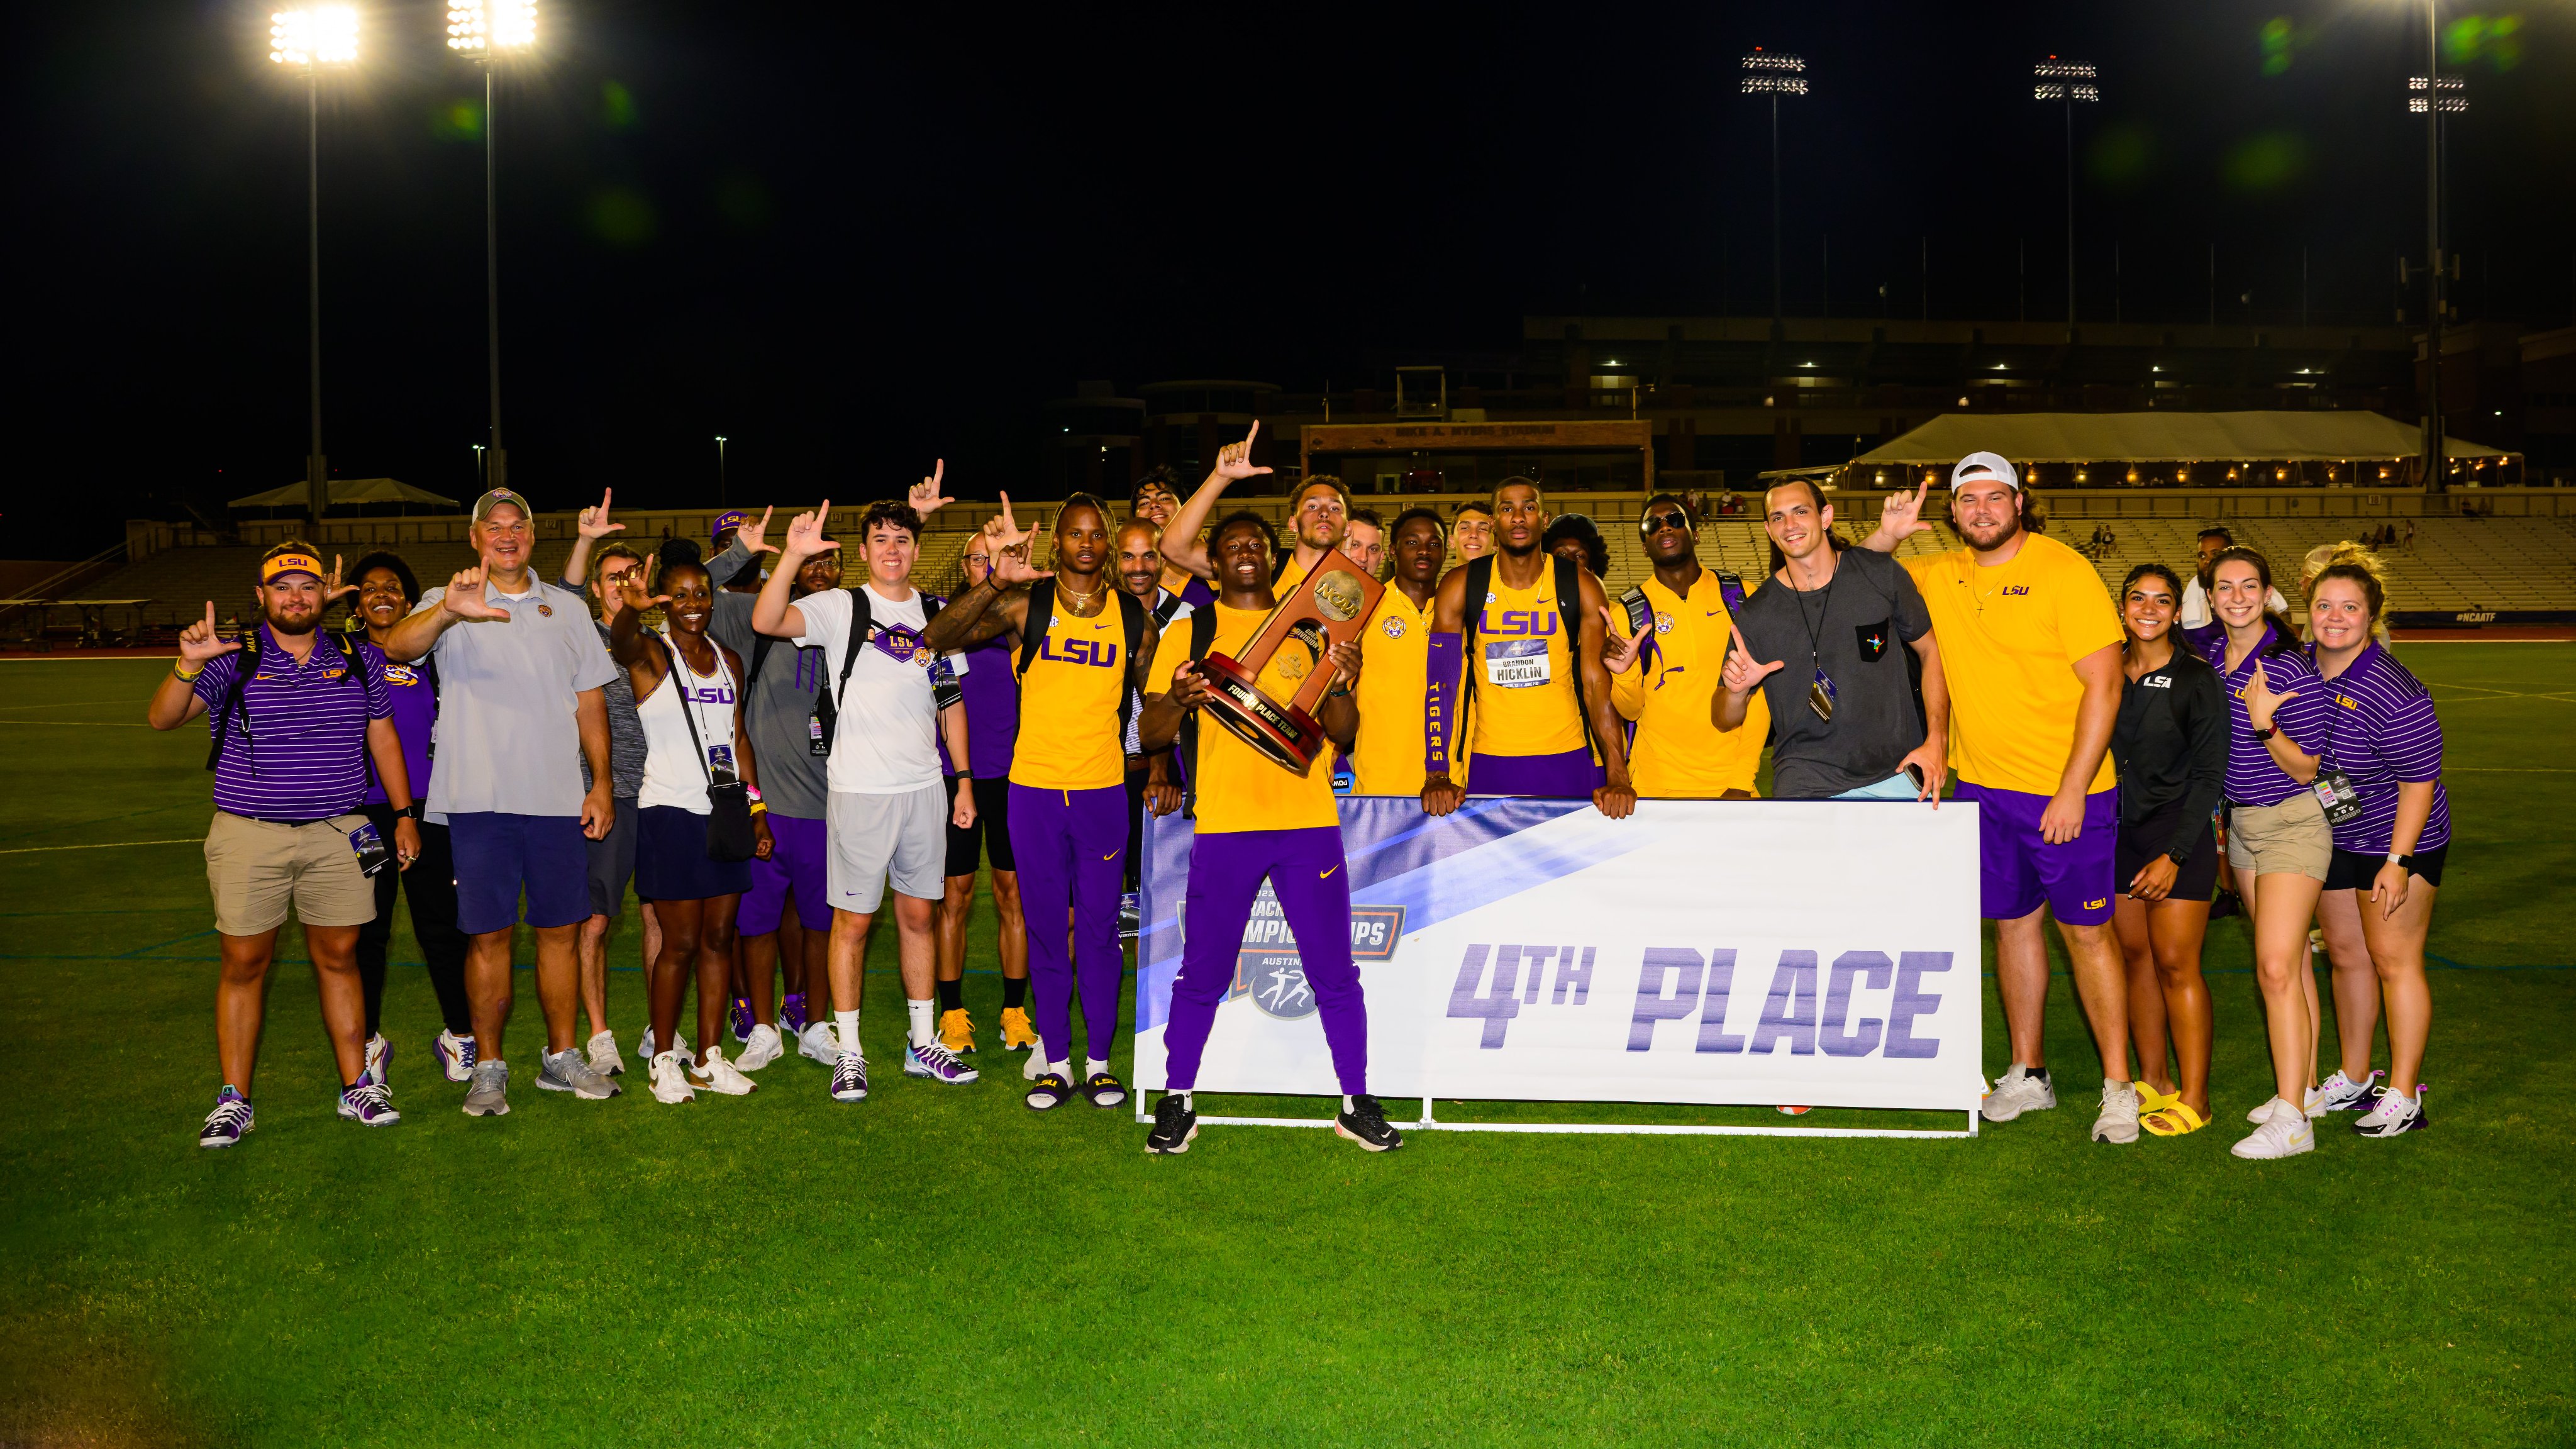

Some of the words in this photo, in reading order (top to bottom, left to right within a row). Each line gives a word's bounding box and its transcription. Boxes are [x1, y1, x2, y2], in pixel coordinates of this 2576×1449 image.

[1451, 426, 1495, 436] MYERS
[1502, 425, 1555, 435] STADIUM
[279, 558, 308, 567] LSU
[2002, 585, 2029, 596] LSU
[1315, 582, 1359, 619] NCAA
[1479, 609, 1557, 636] LSU
[2456, 612, 2496, 622] #NCAATF
[245, 637, 257, 652] MAX
[1294, 628, 1320, 649] DIVISION
[1041, 635, 1117, 668] LSU
[1502, 658, 1534, 667] BRANDON
[1497, 666, 1542, 681] HICKLIN
[682, 686, 735, 704] LSU
[2335, 694, 2358, 710] LSU
[1227, 684, 1260, 709] FOURTH
[1255, 702, 1280, 724] PLACE
[1277, 719, 1298, 739] TEAM
[1429, 681, 1443, 761] TIGERS
[1250, 901, 1285, 916] RACK
[2083, 897, 2106, 910] LSU
[1446, 943, 1597, 1050] 4TH
[1626, 947, 1955, 1059] PLACE
[1036, 1079, 1058, 1088] LSU
[1095, 1078, 1118, 1087] LSU
